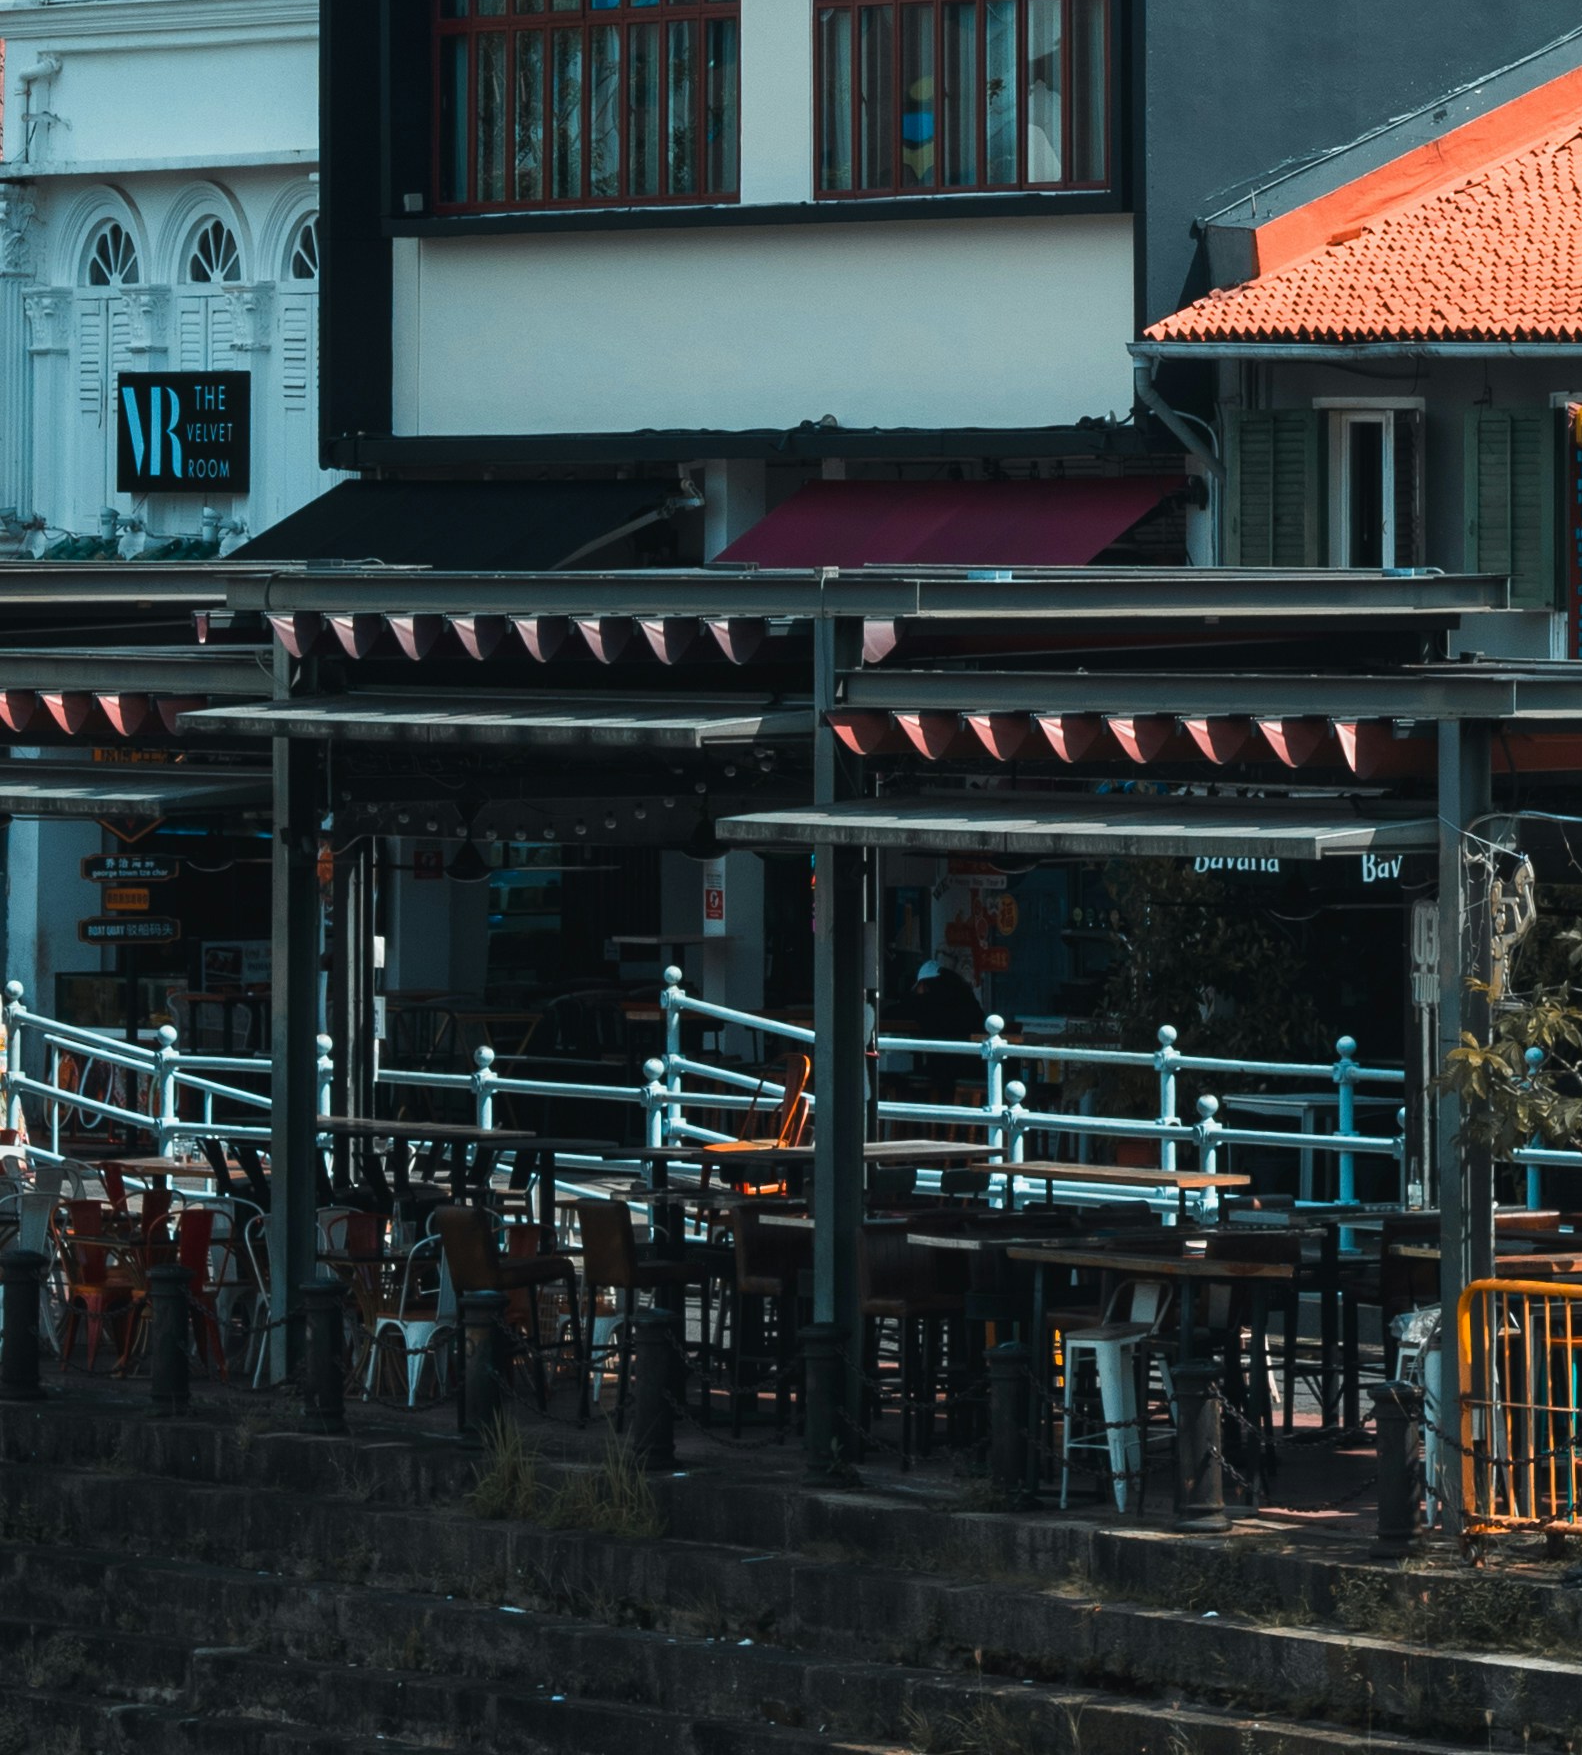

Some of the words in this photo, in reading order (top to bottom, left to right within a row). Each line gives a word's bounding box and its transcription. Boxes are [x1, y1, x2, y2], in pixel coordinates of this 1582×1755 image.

[194, 385, 226, 410] THE
[186, 422, 233, 442] VELVET
[187, 458, 230, 479] ROOM
[92, 870, 117, 879] george
